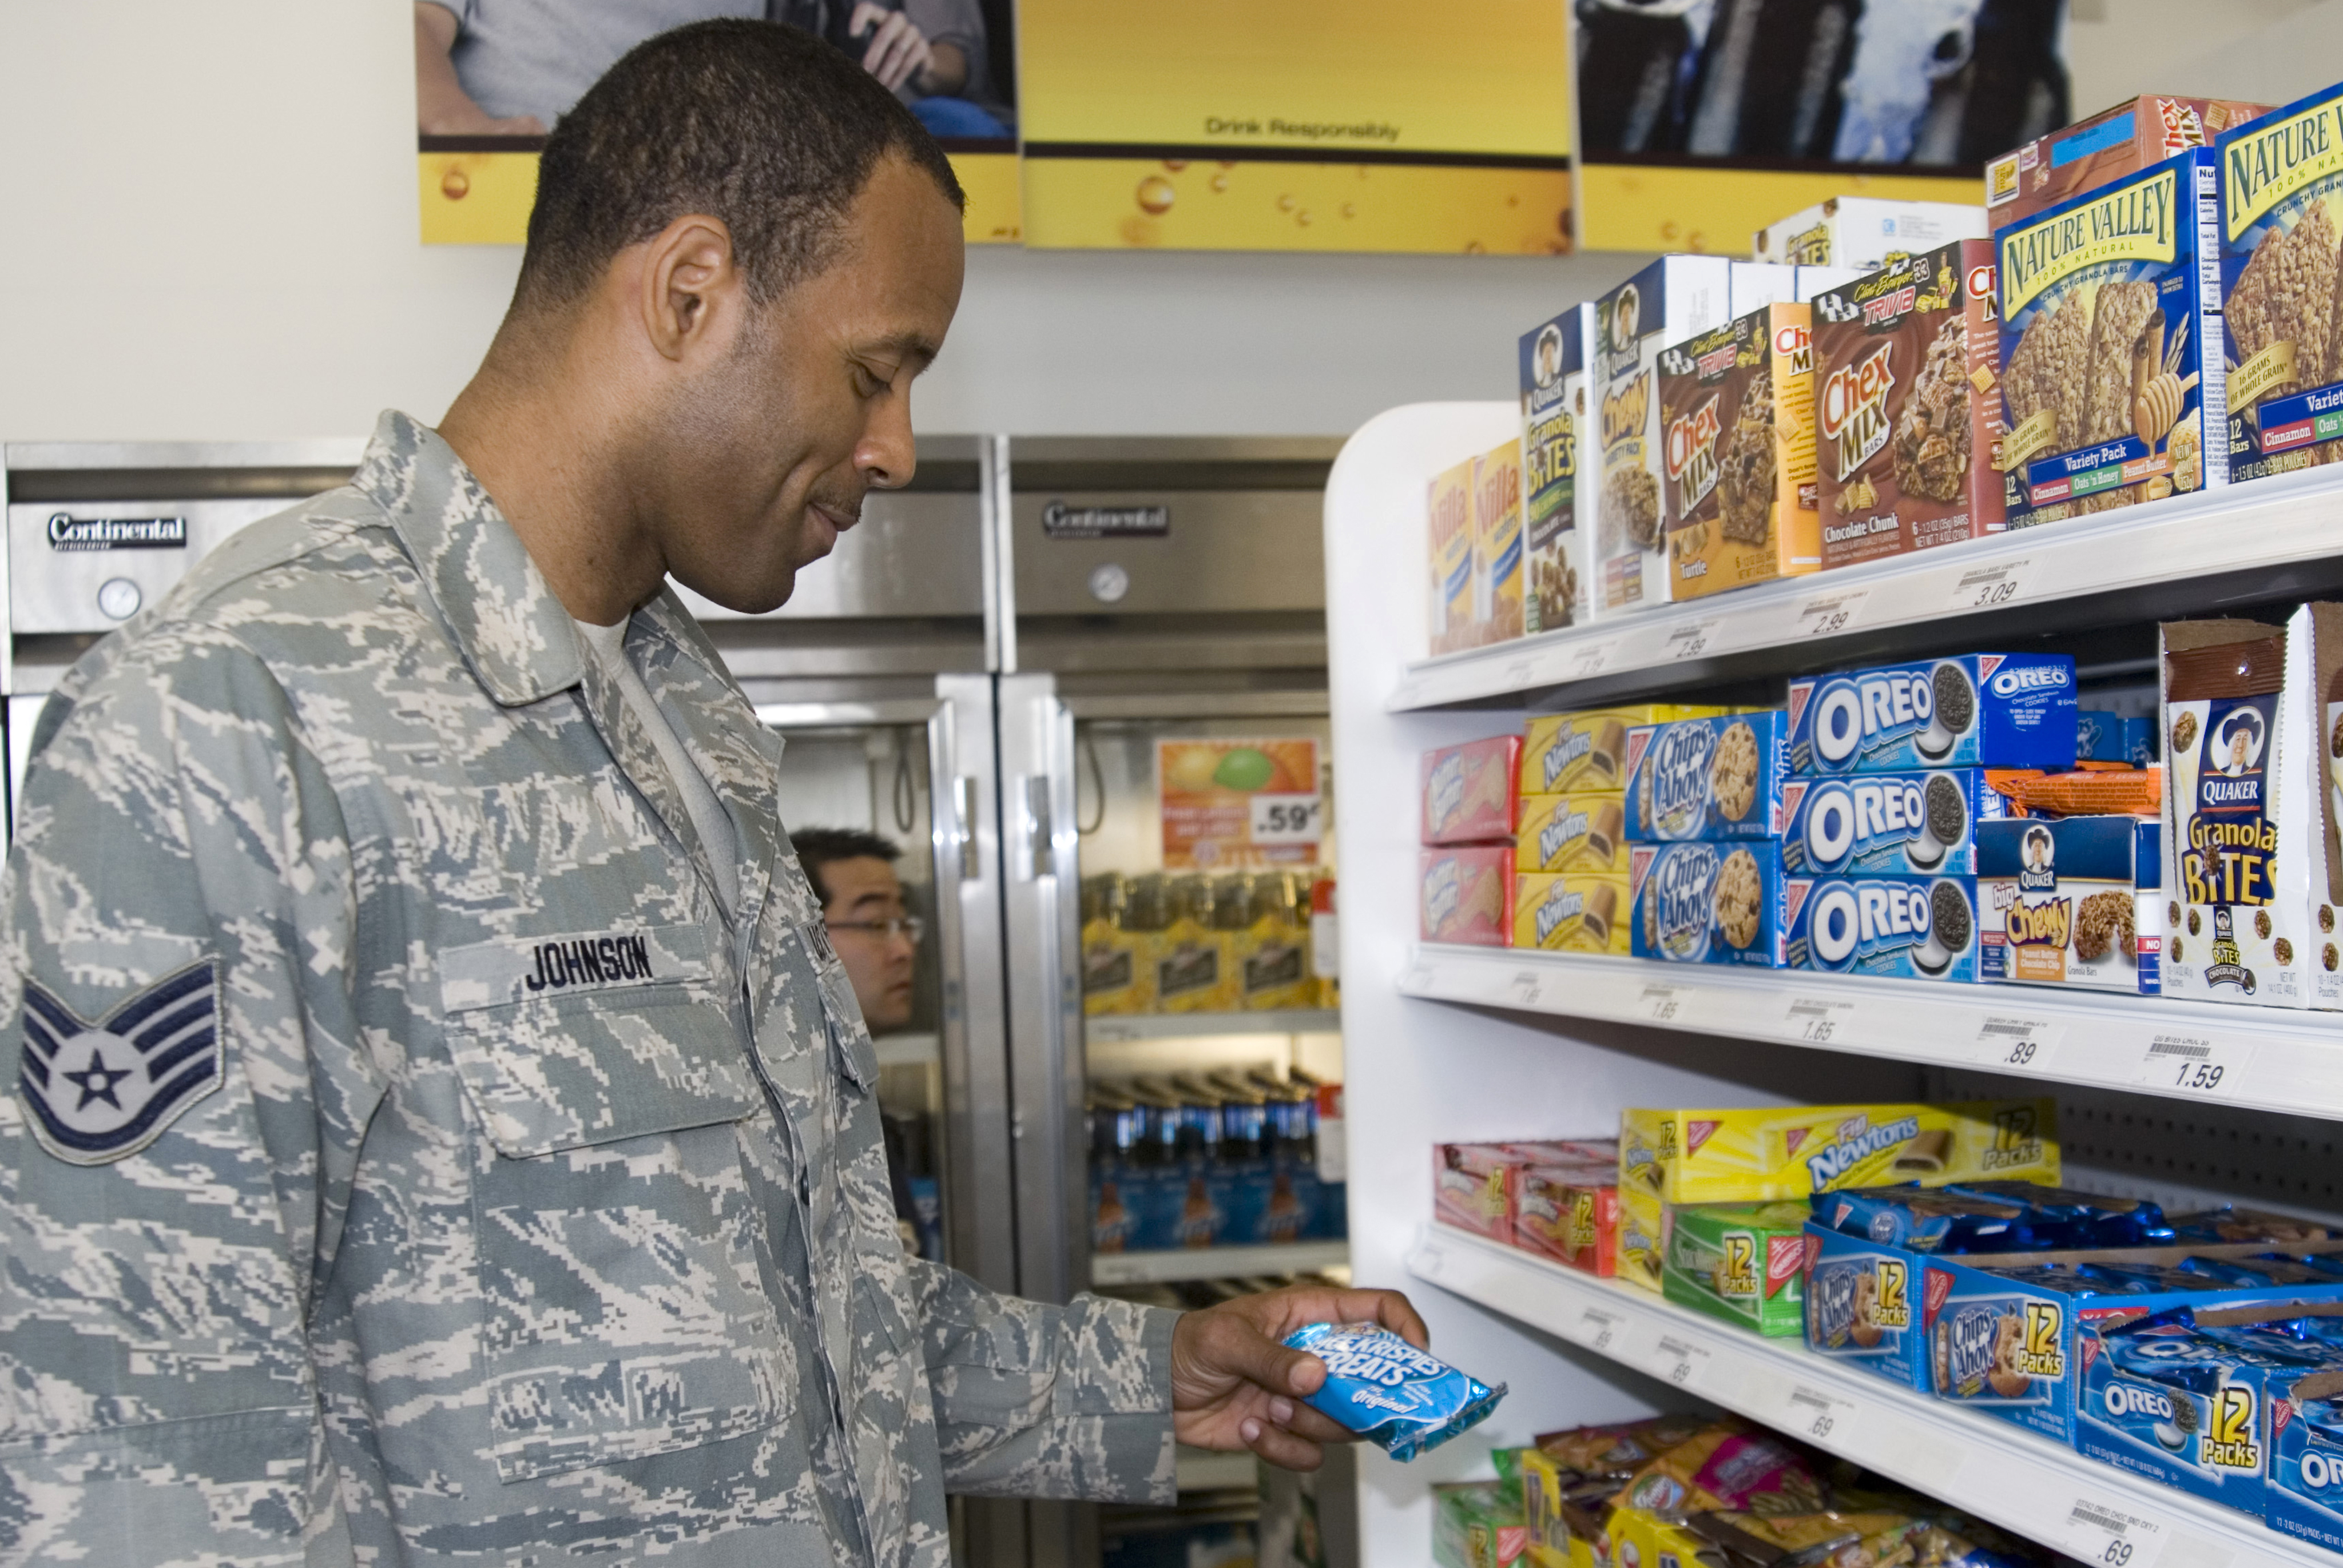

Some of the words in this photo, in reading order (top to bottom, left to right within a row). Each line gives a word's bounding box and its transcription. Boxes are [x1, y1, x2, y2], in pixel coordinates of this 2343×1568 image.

[1205, 117, 1260, 136] Drink
[1269, 118, 1401, 144] Responsibly
[2230, 111, 2330, 223] NATURE
[2269, 169, 2306, 198] 100%
[2277, 190, 2315, 217] CRUNCHY
[1787, 222, 1827, 256] Granola
[2007, 212, 2086, 305] NATURE
[2091, 177, 2172, 245] VALLEY
[1913, 257, 1930, 283] 33
[2036, 261, 2066, 285] 100%
[2075, 241, 2134, 262] NATURAL
[1854, 282, 1877, 303] Clint
[2043, 282, 2073, 303] CRUNCHY
[2075, 269, 2108, 286] GRANOLA
[2110, 265, 2128, 276] BARS
[1864, 285, 1916, 327] TRIVIA
[1611, 341, 1639, 375] QUAKER
[1698, 343, 1737, 380] TRIVIA
[2239, 376, 2246, 386] 16
[2247, 355, 2270, 380] GRAMS
[1533, 377, 1563, 410] QUAKER
[1822, 343, 1893, 437] Chex
[2231, 392, 2238, 405] OF
[2239, 375, 2261, 398] WHOLE
[1602, 372, 1651, 451] Chewy
[1528, 406, 1573, 451] Granola
[1667, 397, 1719, 480] Chex
[1840, 392, 1888, 477] MIX
[2020, 421, 2038, 439] GRAMS
[2230, 418, 2242, 440] 12
[2265, 427, 2312, 447] Cinnamon
[2318, 419, 2338, 433] Oats
[1627, 441, 1642, 455] PACK
[1864, 434, 1883, 458] BARS
[2006, 453, 2014, 463] OF
[2014, 439, 2030, 456] WHOLE
[2066, 453, 2100, 472] Variety
[2100, 443, 2127, 462] Pack
[2230, 440, 2249, 455] Bars
[2284, 451, 2306, 472] POUCHES
[1681, 443, 1716, 516] MIX
[1699, 479, 1713, 497] BARS
[2006, 475, 2016, 494] 12
[2034, 484, 2069, 500] Cinnamon
[2074, 477, 2090, 490] Oats
[2098, 469, 2119, 485] Honey
[2123, 463, 2146, 478] Peanut
[2146, 459, 2167, 473] Butter
[1045, 501, 1167, 528] Continental
[2006, 495, 2022, 507] Bars
[50, 515, 184, 542] Continental
[1825, 522, 1867, 544] Chocolate
[1869, 512, 1900, 534] Chunk
[1953, 514, 1969, 526] BARS
[1680, 559, 1707, 579] Turtle
[1974, 580, 2018, 607] 3.09
[1812, 611, 1850, 634] 2.99
[1677, 638, 1706, 658] 2.99
[1994, 671, 2067, 694] OREO
[2012, 695, 2037, 705] Chocolate
[2025, 697, 2049, 707] COOKIES
[1815, 678, 1933, 761] OREO
[1544, 731, 1592, 789] Newtons
[1659, 722, 1712, 776] Chips
[1879, 751, 1900, 766] COOKIES
[1658, 734, 1717, 814] Ahoy!
[2203, 780, 2258, 805] QUAKER
[1810, 786, 1924, 863] OREO
[2189, 816, 2276, 852] Granola
[1539, 813, 1588, 870] Newtons
[1663, 846, 1714, 898] Chips
[1871, 859, 1891, 873] COOKIES
[2022, 870, 2054, 888] QUAKER
[1662, 860, 1719, 937] Ahoy!
[1993, 884, 2015, 911] big
[1535, 892, 1583, 946] Newtons
[1814, 888, 1930, 962] OREO
[2006, 896, 2071, 949] Chewy
[2041, 949, 2059, 959] Butter
[2146, 940, 2161, 950] NO
[2213, 940, 2238, 950] Granola
[526, 936, 654, 992] JOHNSON
[1876, 961, 1897, 974] COOKIES
[2047, 960, 2060, 971] Chip
[2067, 966, 2084, 977] Granola
[2085, 966, 2097, 977] Bars
[2209, 969, 2241, 980] CHOCOLATE
[2280, 972, 2288, 982] NET
[2318, 986, 2340, 998] Pouches
[1651, 1001, 1679, 1020] 1.65
[1802, 1020, 1836, 1041] 1.65
[2004, 1041, 2037, 1064] .89
[2175, 1062, 2225, 1089] 1.59
[1661, 1120, 1677, 1146] 12
[1837, 1115, 1868, 1143] Fig
[1996, 1107, 2036, 1150] 12
[1807, 1117, 1919, 1193] Newtons
[1983, 1145, 2042, 1170] Packs
[1488, 1167, 1504, 1196] 12
[1575, 1193, 1594, 1227] 12
[1571, 1225, 1595, 1244] Packs
[1725, 1236, 1753, 1279] 12
[1723, 1273, 1757, 1294] Packs
[1823, 1272, 1851, 1308] Chips
[1878, 1262, 1907, 1308] 12
[1873, 1304, 1908, 1327] Packs
[1953, 1308, 1991, 1348] Chips
[2027, 1304, 2059, 1355] 12
[1353, 1338, 1447, 1376] KRISPIES
[1954, 1317, 2000, 1381] Ahoy!
[1669, 1363, 1691, 1382] .69
[2018, 1350, 2063, 1376] Packs
[1351, 1390, 1419, 1414] Original
[2104, 1384, 2173, 1419] OREO
[1807, 1416, 1834, 1437] .69
[2210, 1387, 2250, 1445] 12
[2202, 1440, 2257, 1470] Packs
[2076, 1499, 2095, 1511] 03742
[2094, 1505, 2110, 1517] OREO
[2111, 1510, 2128, 1522] CHOC
[2127, 1517, 2140, 1527] SND
[2140, 1521, 2154, 1531] CKY
[2153, 1525, 2159, 1533] 2
[2288, 1520, 2295, 1530] OZ
[2295, 1522, 2308, 1537] (57g)
[2308, 1527, 2321, 1540] PACKS
[2324, 1533, 2333, 1544] NET
[2333, 1535, 2340, 1547] WT
[2097, 1539, 2134, 1567] .69
